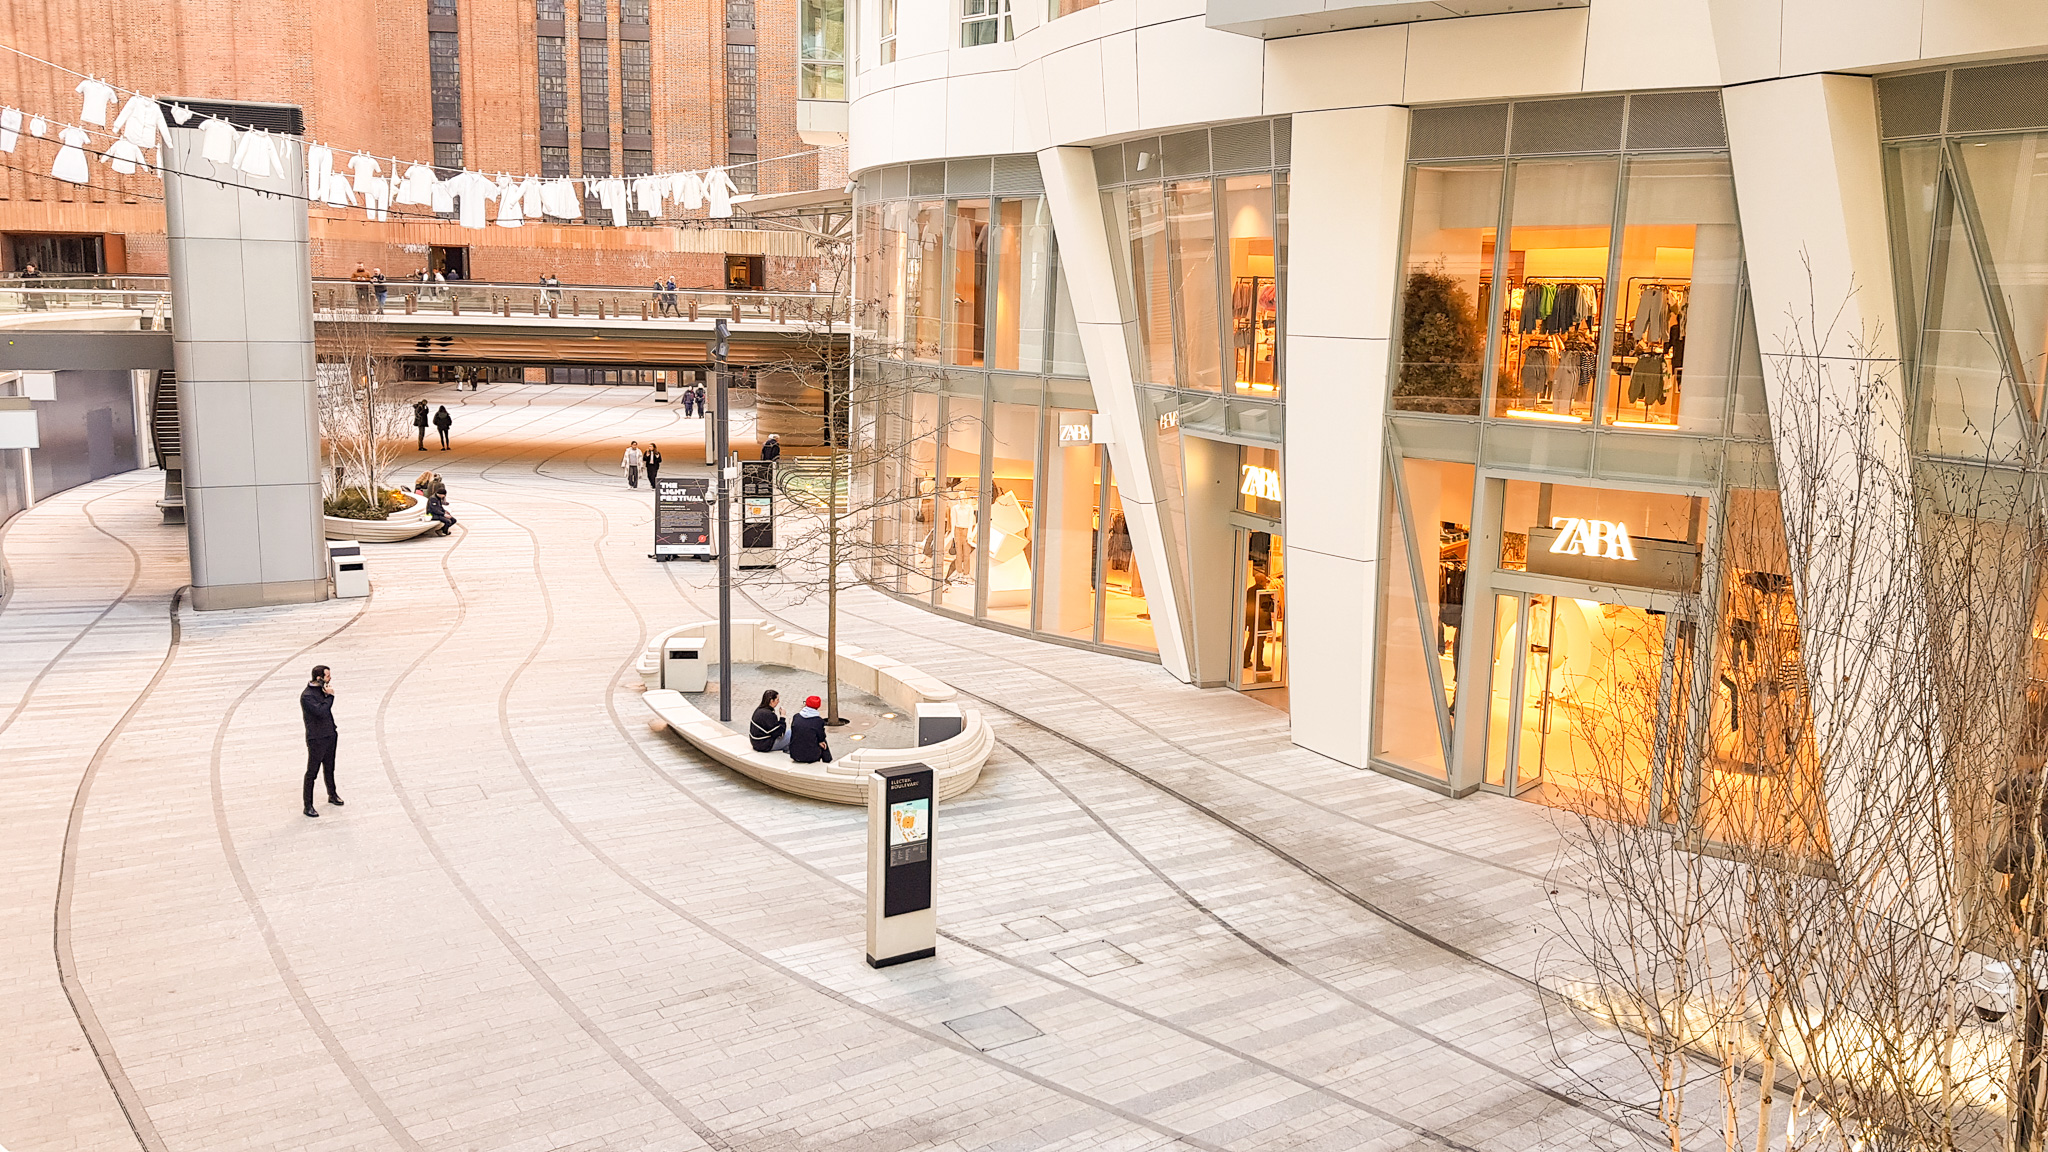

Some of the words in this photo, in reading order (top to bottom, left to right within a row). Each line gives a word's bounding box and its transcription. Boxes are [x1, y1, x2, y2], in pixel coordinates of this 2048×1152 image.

[1060, 424, 1090, 441] ZARA
[1241, 464, 1282, 502] ZARA
[1549, 516, 1639, 561] ZARA
